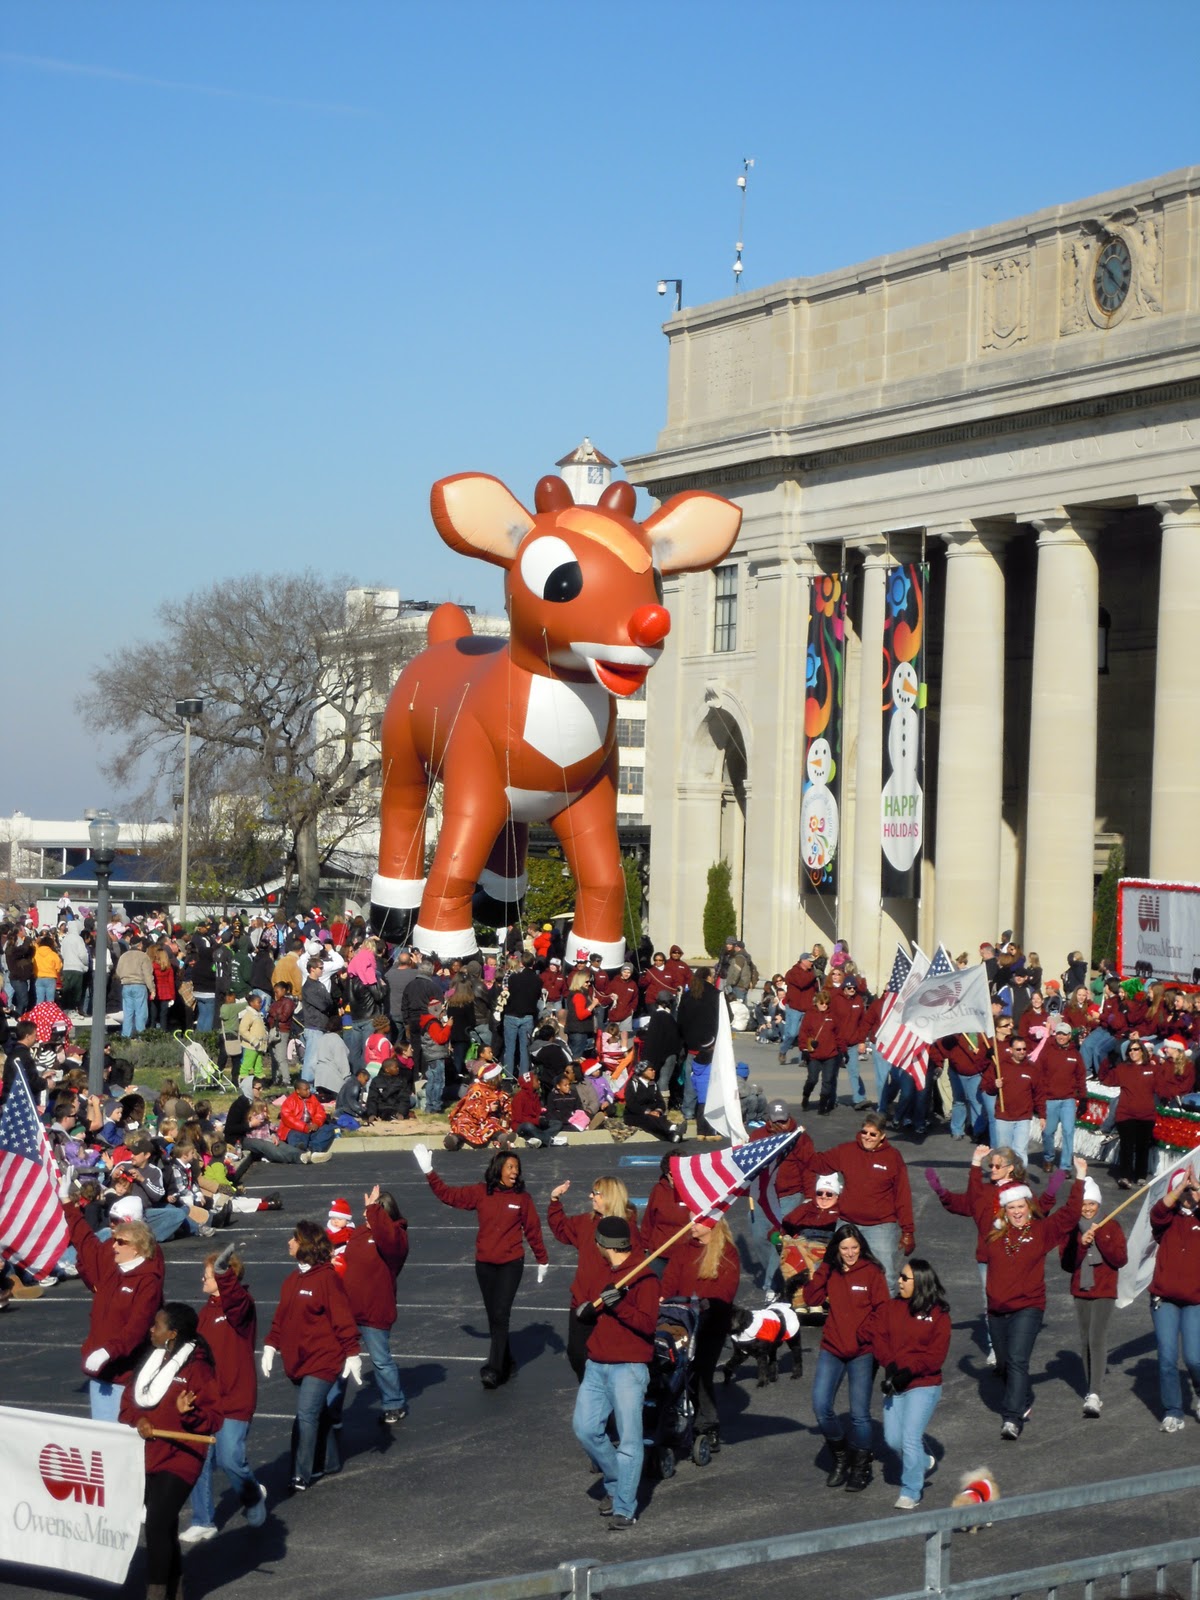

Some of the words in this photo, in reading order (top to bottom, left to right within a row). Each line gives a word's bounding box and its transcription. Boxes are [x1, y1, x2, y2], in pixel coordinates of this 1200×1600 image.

[917, 448, 989, 486] UNION
[1007, 430, 1103, 472] STATION
[1131, 417, 1164, 450] OF
[884, 794, 920, 817] HAPPY
